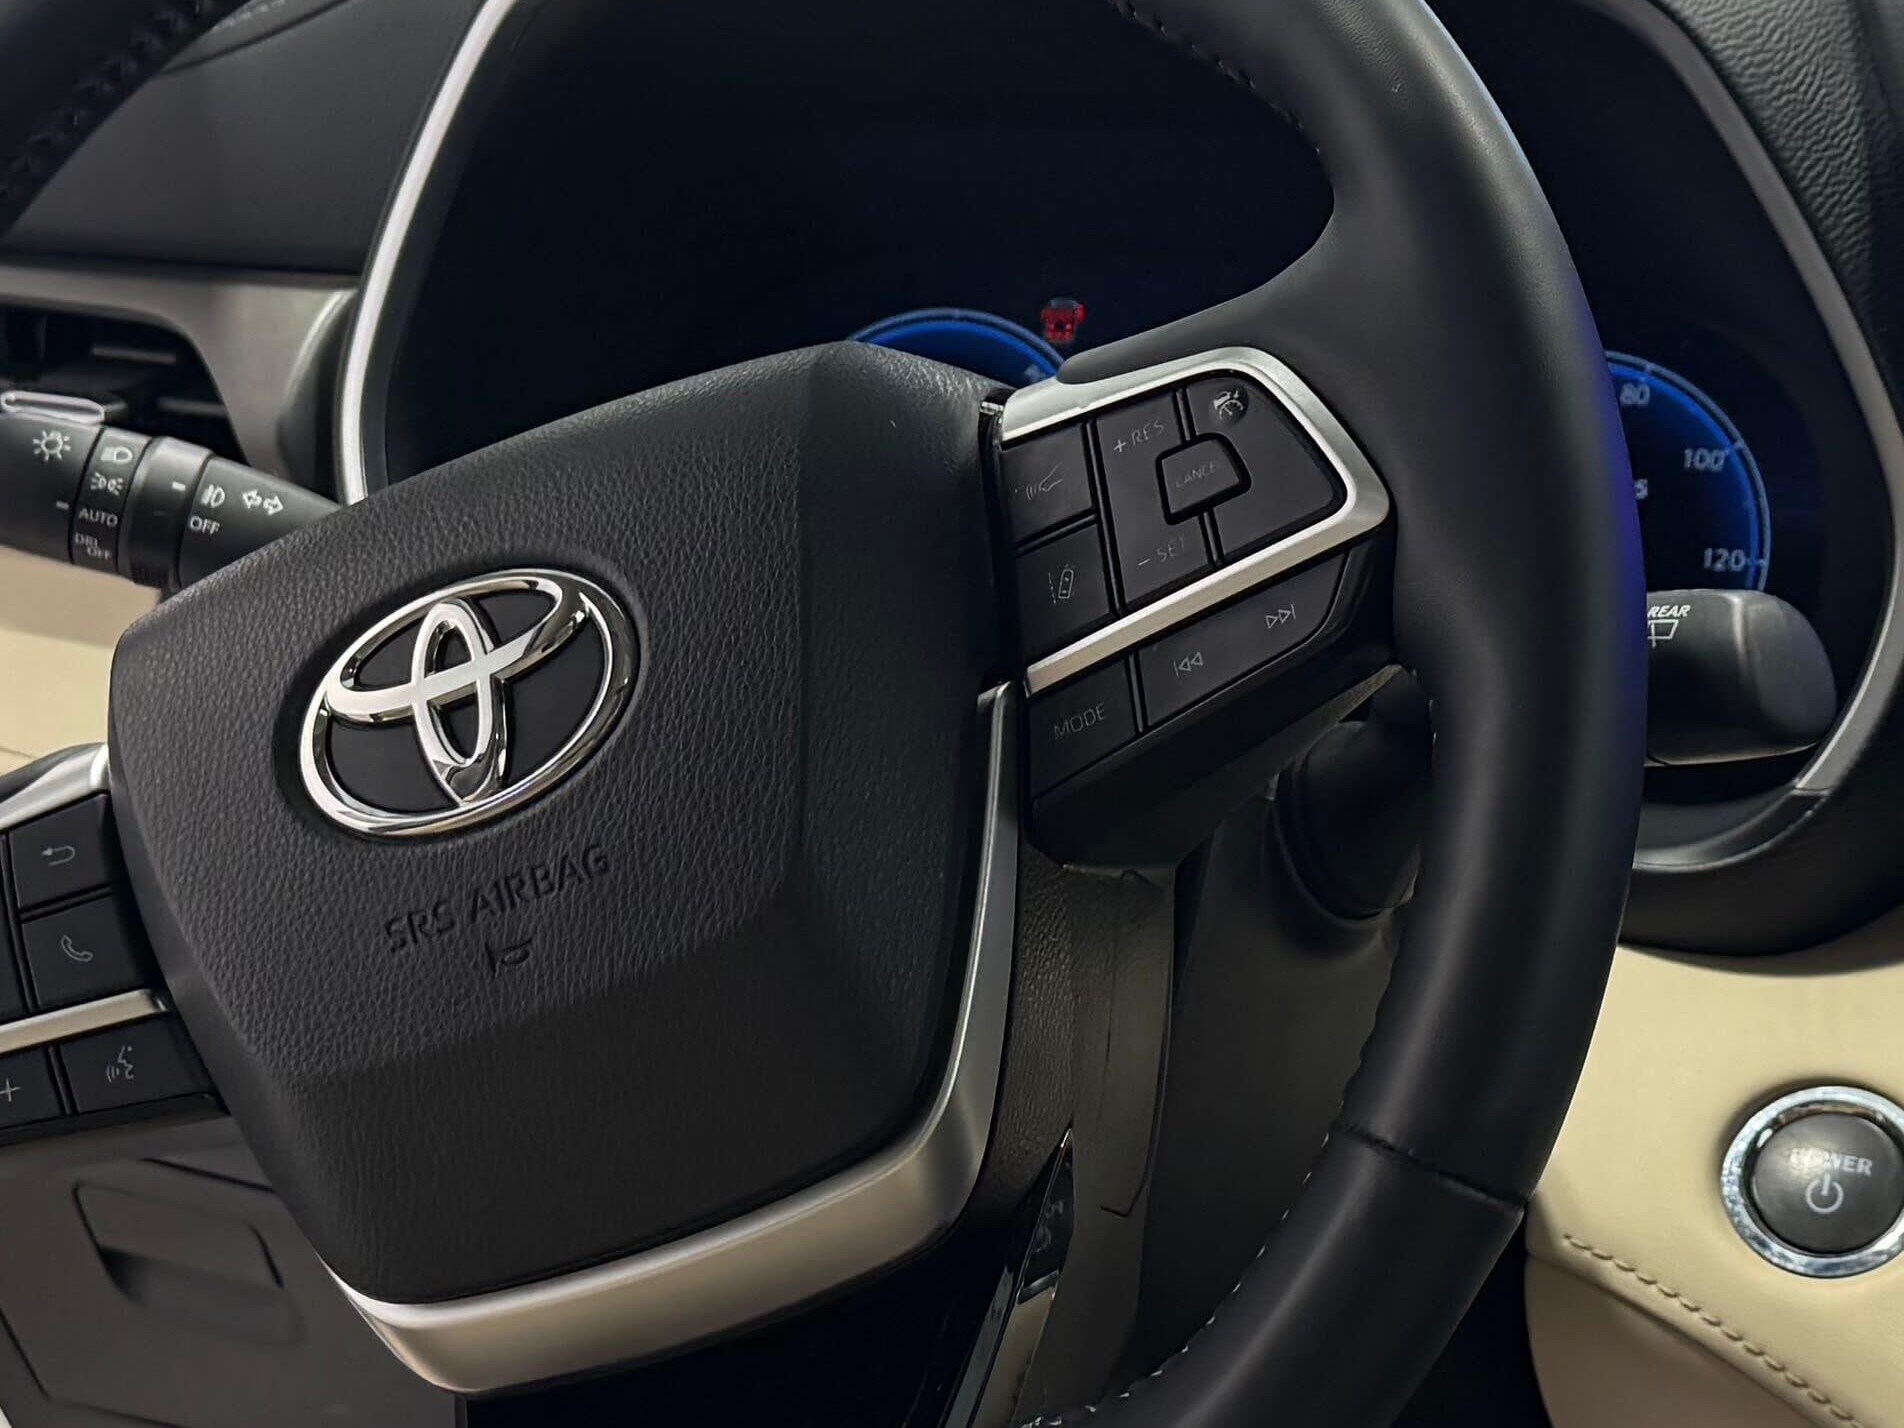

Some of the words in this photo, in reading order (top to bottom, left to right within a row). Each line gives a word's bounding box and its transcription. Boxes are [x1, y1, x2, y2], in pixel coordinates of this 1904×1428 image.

[1619, 383, 1651, 406] 80
[1131, 420, 1165, 447] RES
[1683, 448, 1726, 472] 100
[1175, 459, 1219, 489] CANCE
[77, 507, 119, 528] AUTO
[189, 515, 221, 535] OFF
[87, 544, 112, 560] OFF
[1703, 547, 1747, 572] 120
[1646, 604, 1692, 618] REAR
[1053, 701, 1105, 740] MODE
[383, 900, 457, 954] SRS
[469, 843, 610, 924] AIRBAG
[1788, 1147, 1874, 1178] WER
